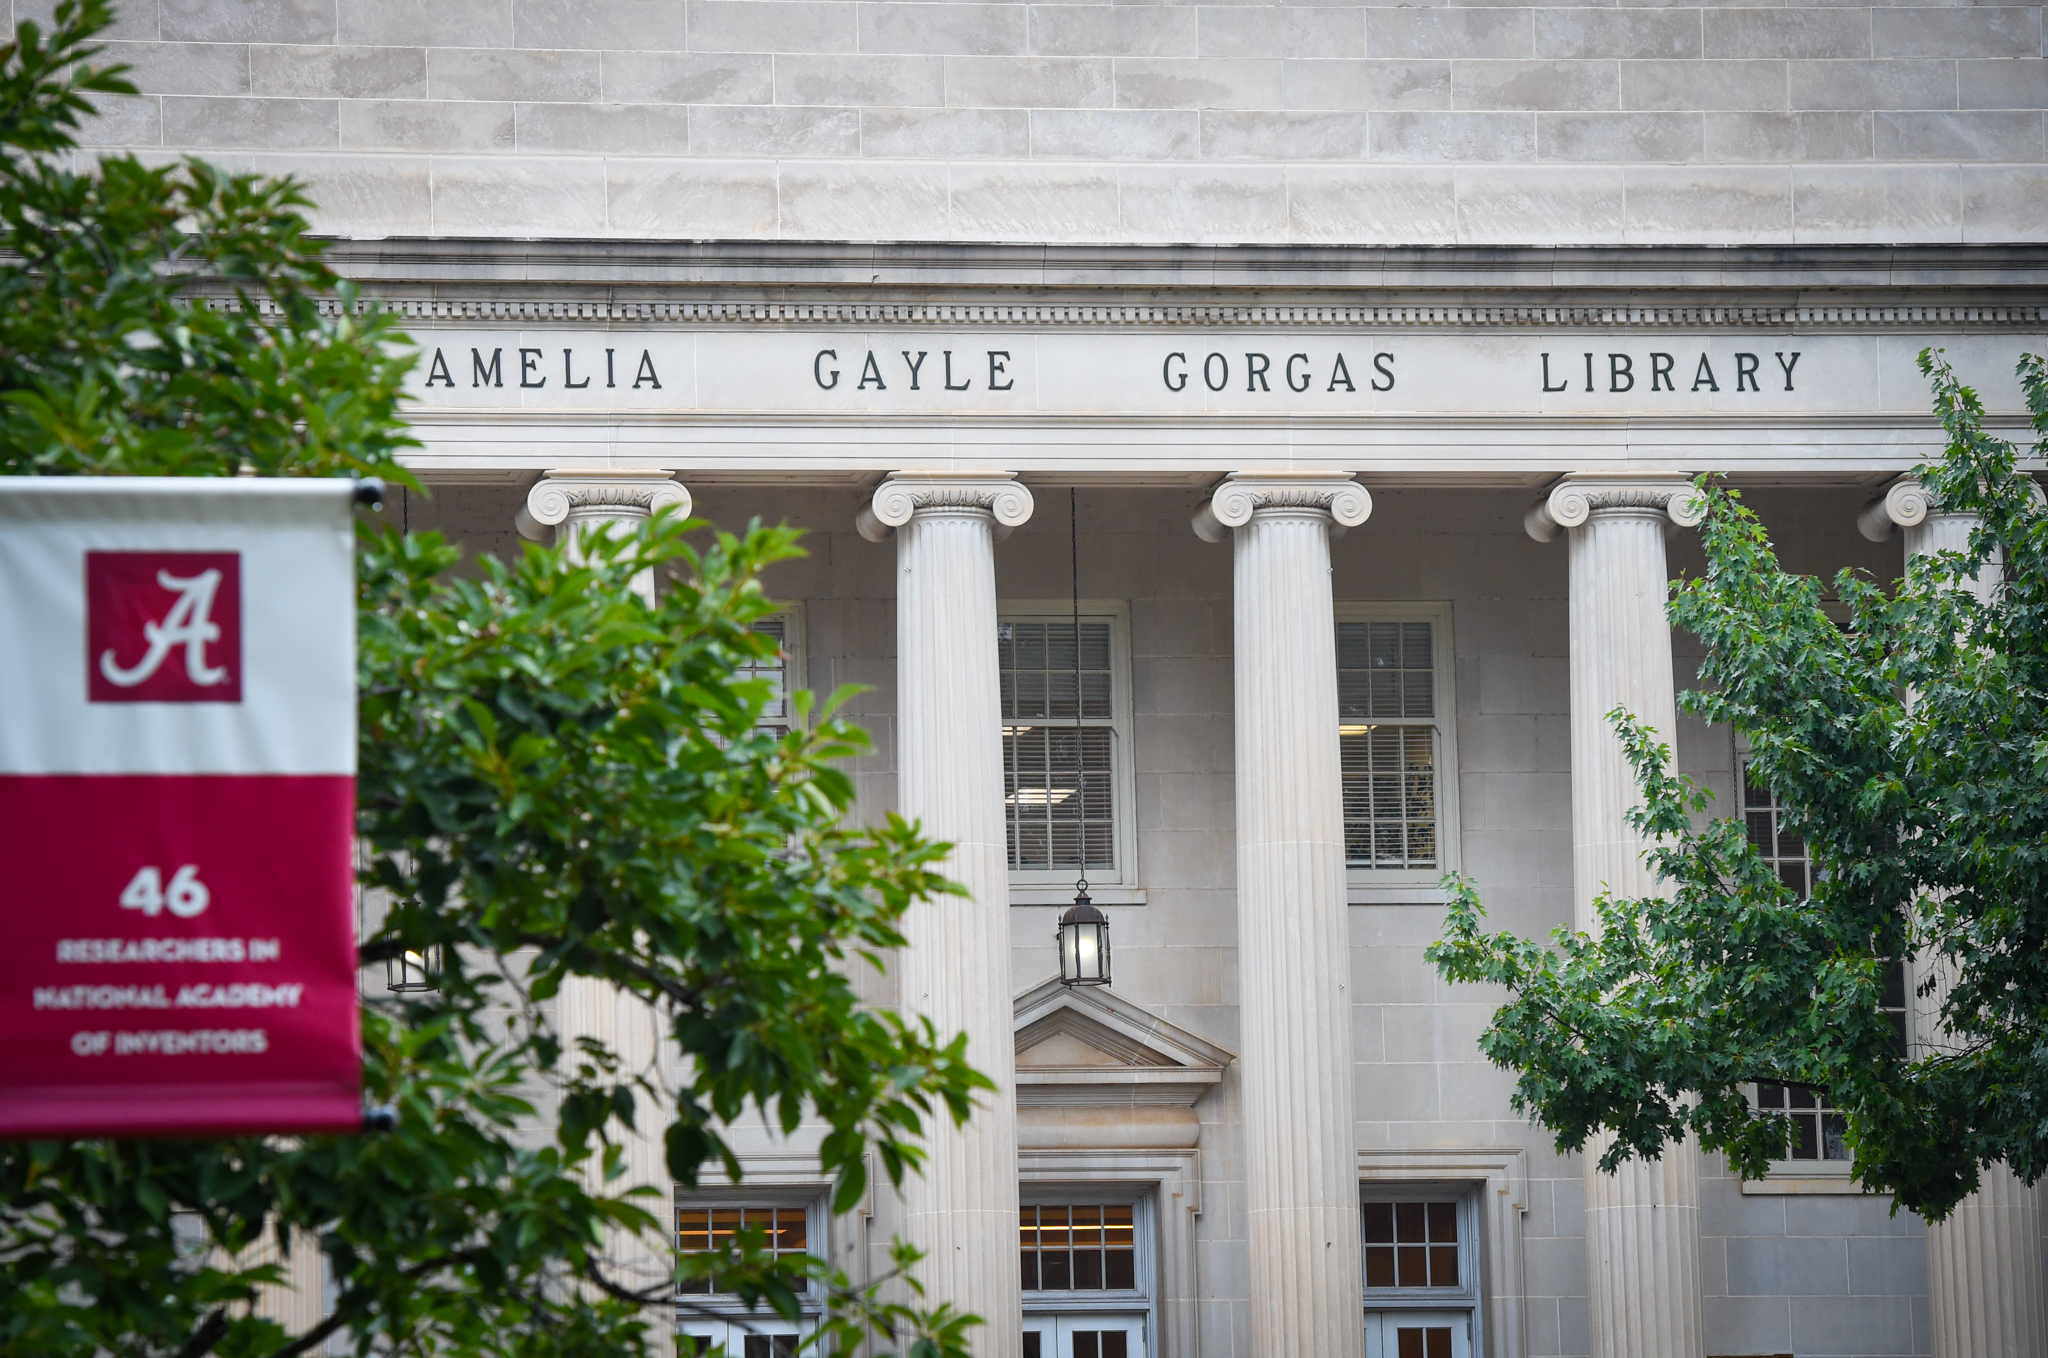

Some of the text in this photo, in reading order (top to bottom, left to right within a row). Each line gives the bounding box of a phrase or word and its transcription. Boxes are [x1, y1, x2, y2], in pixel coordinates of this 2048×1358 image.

[425, 346, 1801, 393] AMELIA GAYLE GORGAS LIBRARY
[100, 569, 224, 686] A
[119, 865, 210, 918] 46
[56, 939, 280, 963] RESEARCHERS IN
[32, 984, 304, 1010] NATIONAL ACADEMY
[71, 1031, 267, 1056] OF INVENTORS
